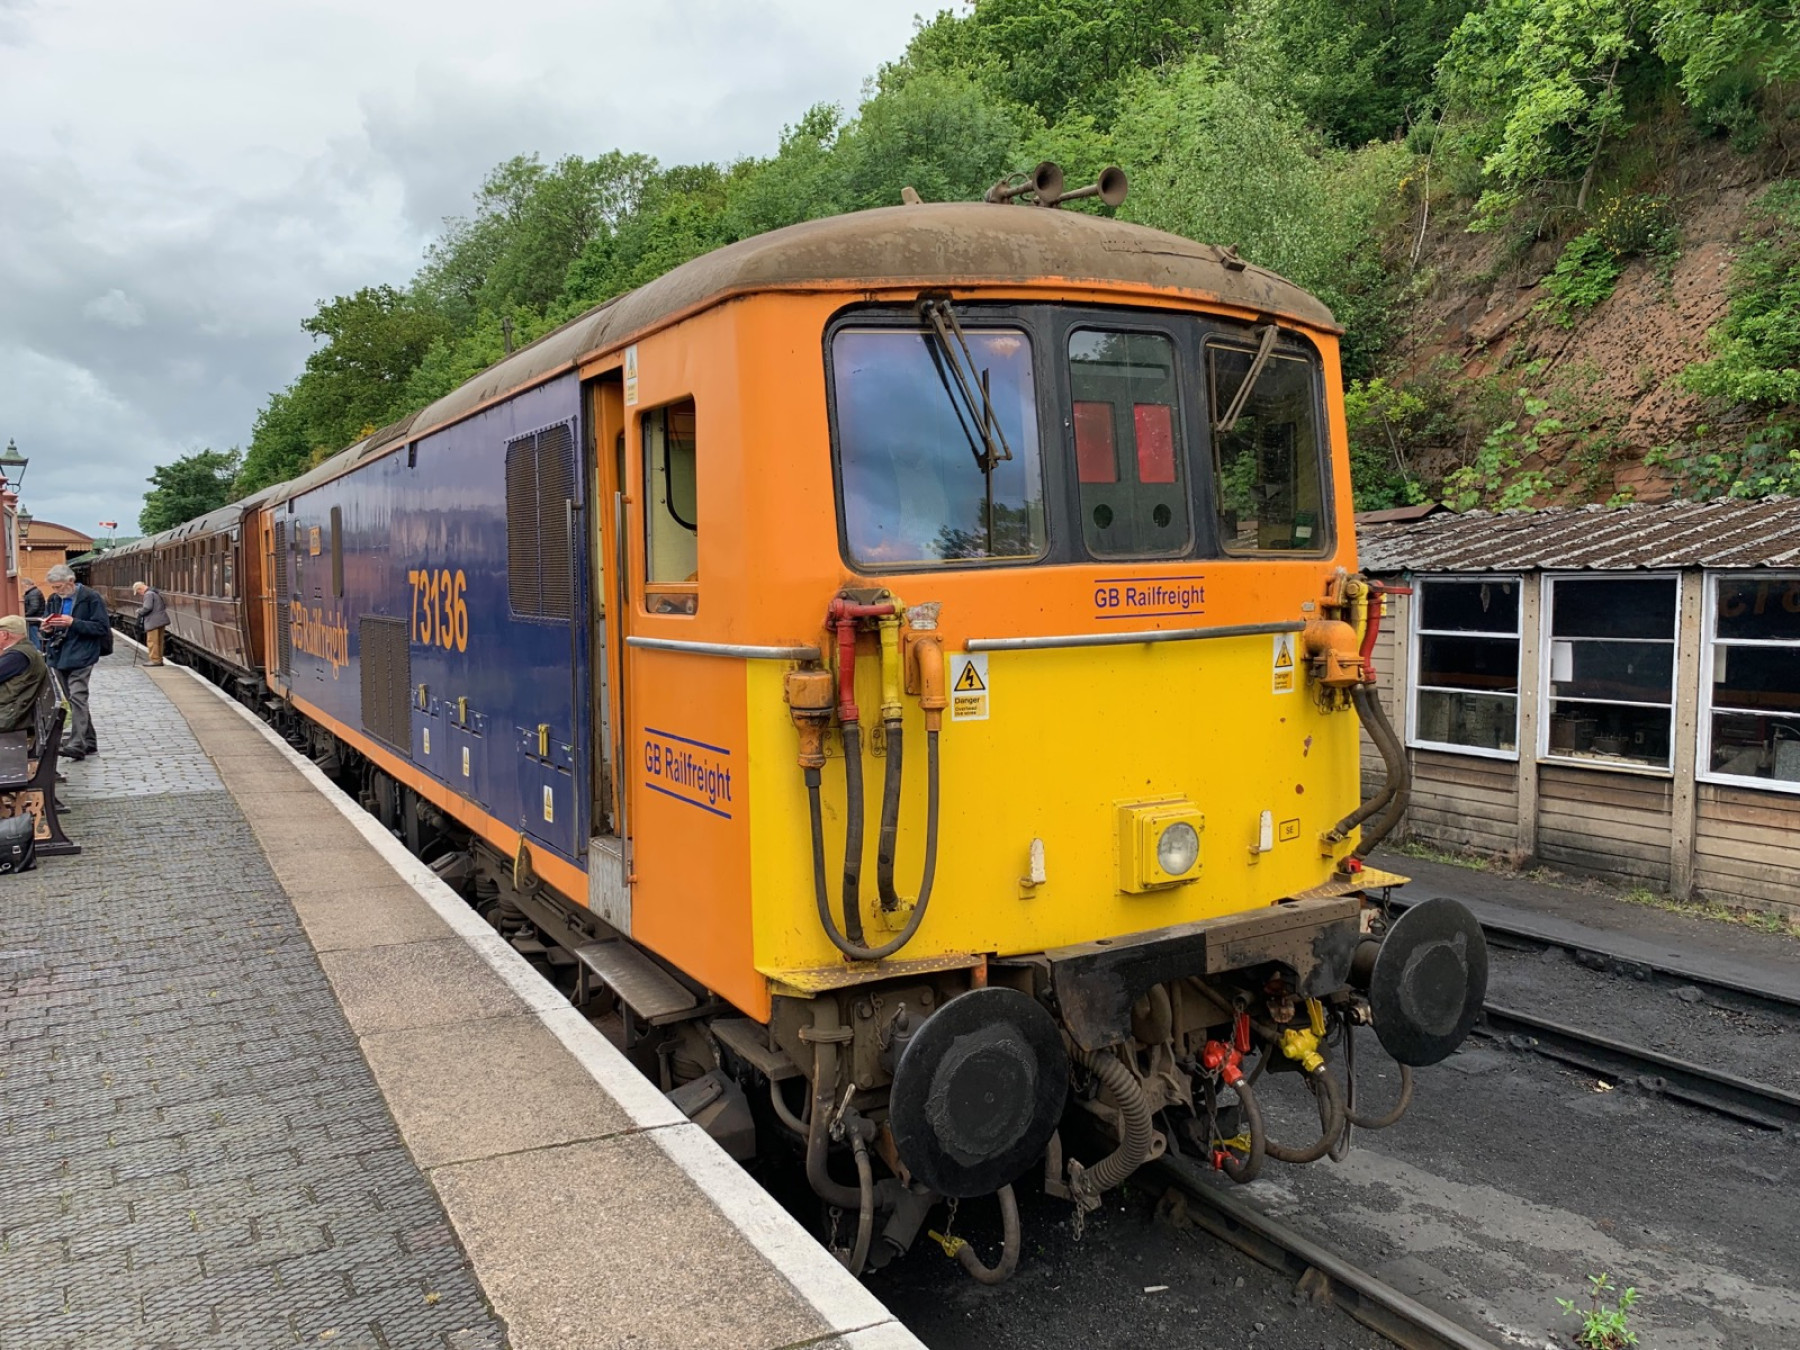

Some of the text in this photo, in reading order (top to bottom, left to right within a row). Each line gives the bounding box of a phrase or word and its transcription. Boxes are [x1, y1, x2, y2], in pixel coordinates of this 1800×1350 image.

[409, 569, 468, 653] 73136
[1094, 585, 1205, 609] GB Railfreight
[303, 607, 349, 680] Railfreight
[954, 697, 980, 705] Danger
[645, 741, 732, 805] GB Railfreight
